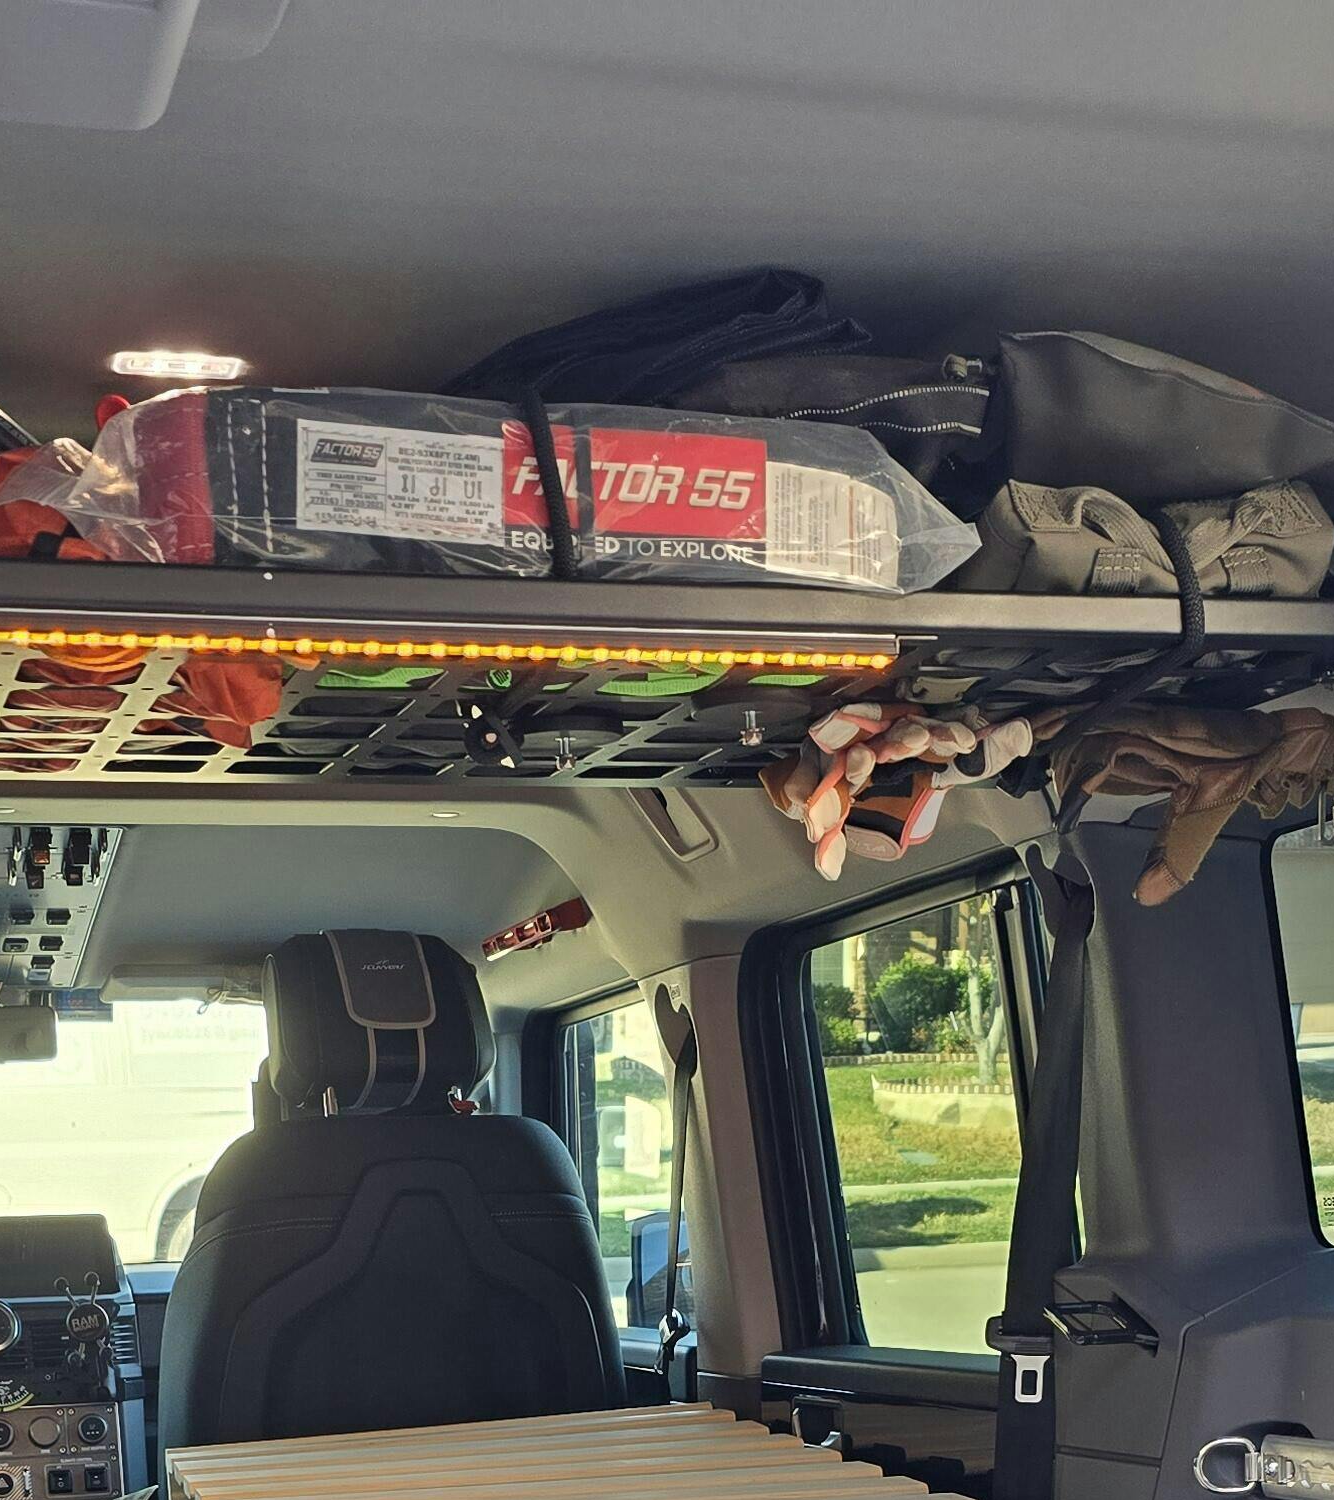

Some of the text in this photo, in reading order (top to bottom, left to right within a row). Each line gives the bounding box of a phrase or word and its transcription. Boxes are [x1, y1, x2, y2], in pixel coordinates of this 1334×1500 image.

[314, 441, 383, 459] FACTOR 55
[689, 468, 755, 511] 55
[511, 530, 621, 556] EQUED
[626, 538, 655, 557] TO
[71, 1313, 98, 1330] RAM
